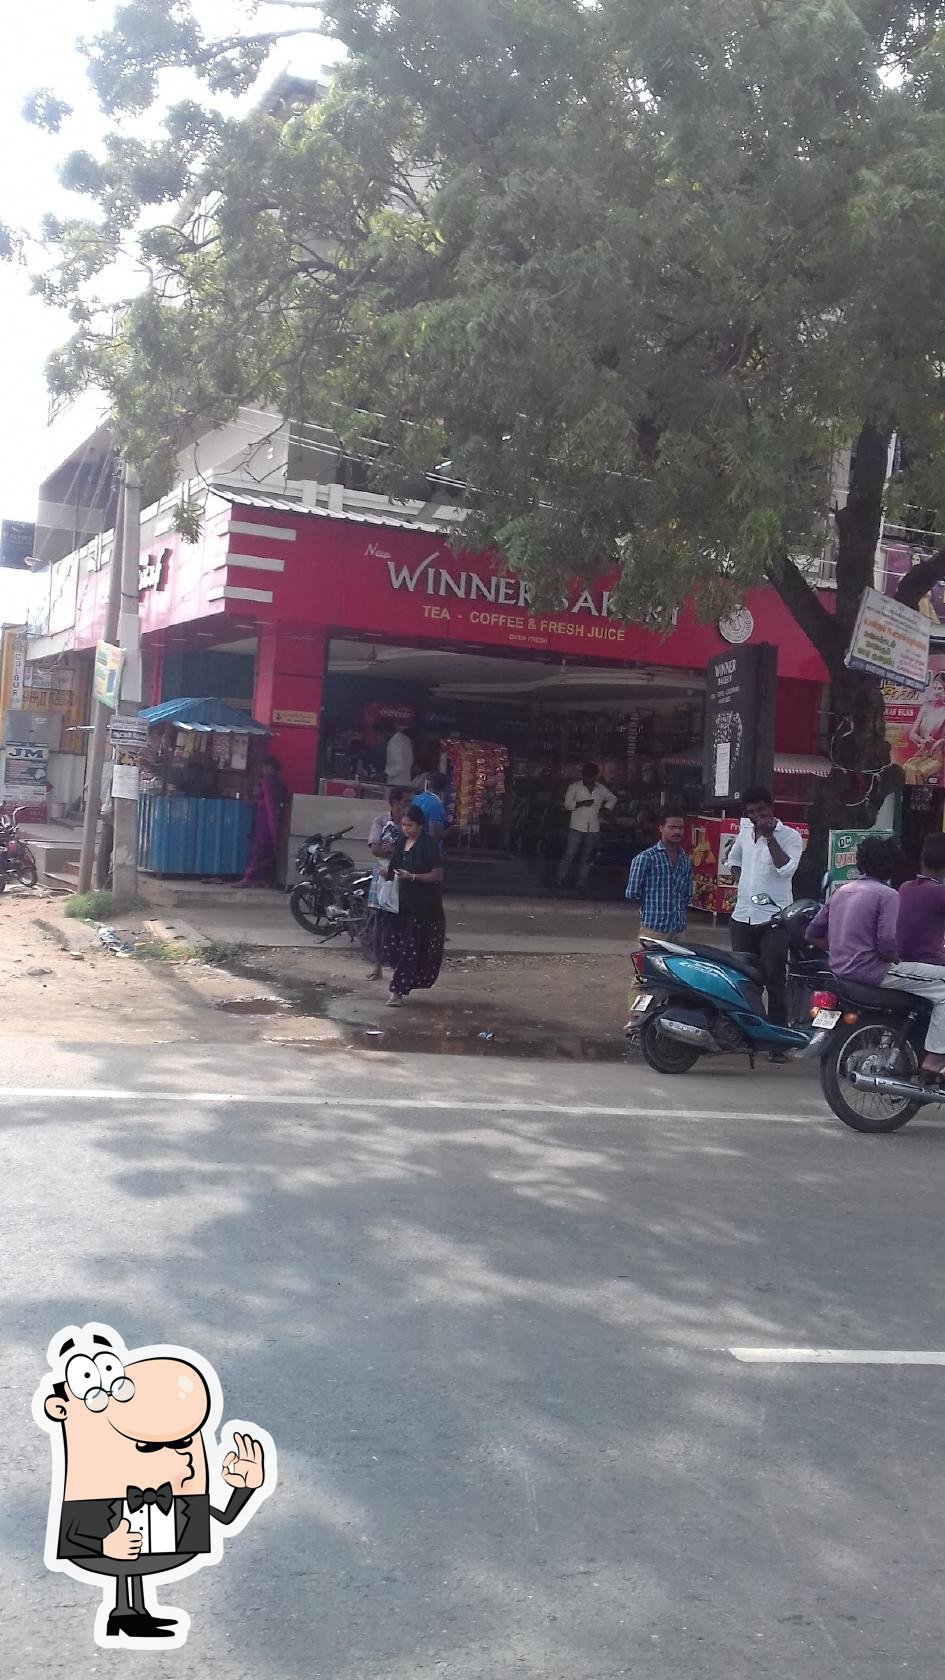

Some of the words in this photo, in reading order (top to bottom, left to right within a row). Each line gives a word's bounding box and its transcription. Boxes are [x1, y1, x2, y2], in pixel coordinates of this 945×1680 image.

[422, 605, 450, 620] TEA
[470, 611, 525, 629] COFFEE
[528, 618, 537, 630] &
[540, 620, 584, 637] FRESH
[587, 626, 625, 641] JUICE
[8, 747, 44, 759] JM
